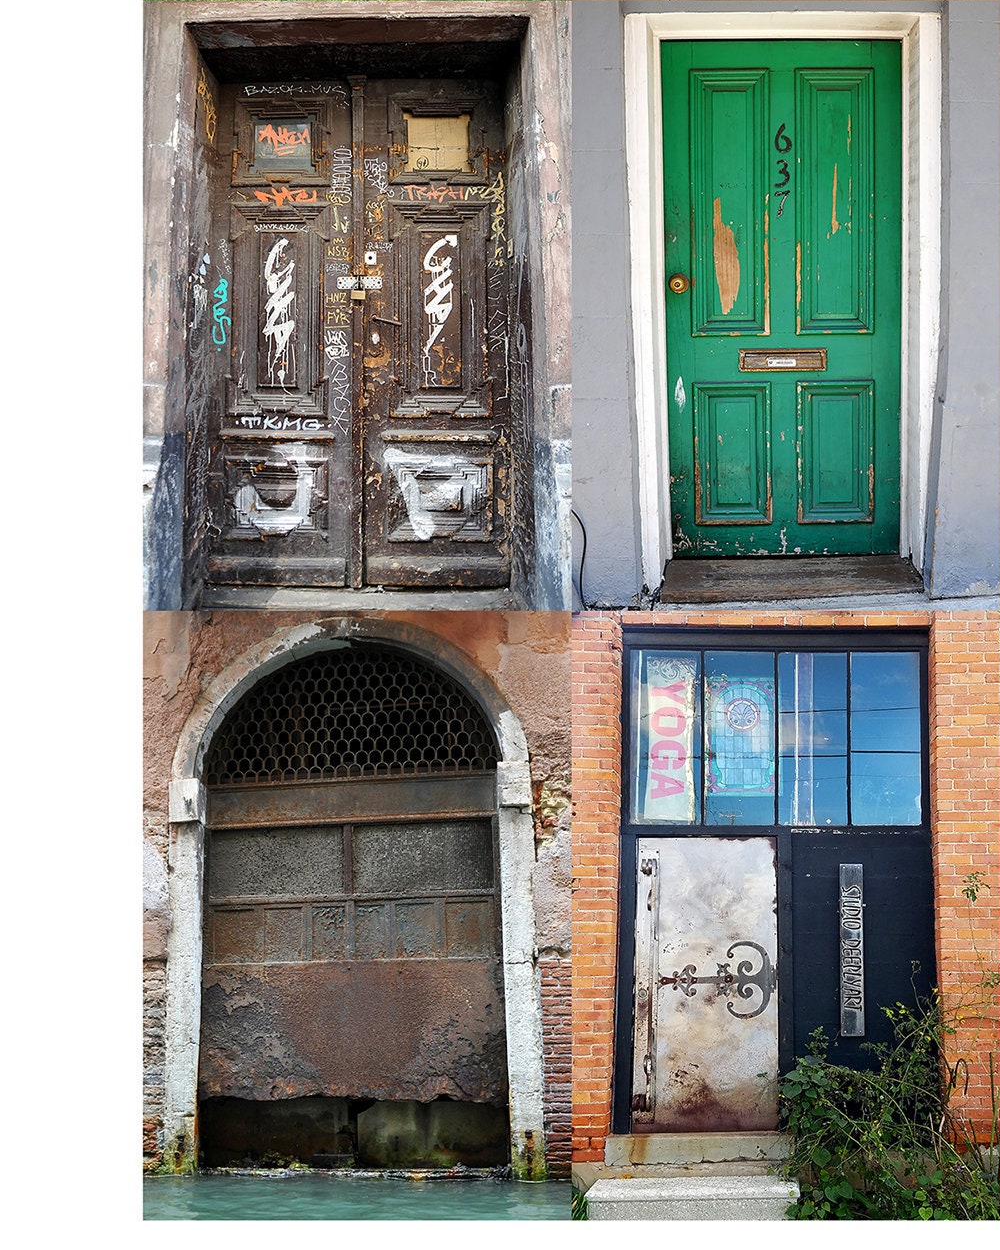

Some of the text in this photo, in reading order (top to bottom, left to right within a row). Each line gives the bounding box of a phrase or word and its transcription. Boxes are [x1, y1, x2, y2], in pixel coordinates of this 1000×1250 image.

[774, 123, 792, 219] 637
[650, 681, 688, 800] YOGA
[841, 885, 862, 930] STUDIO
